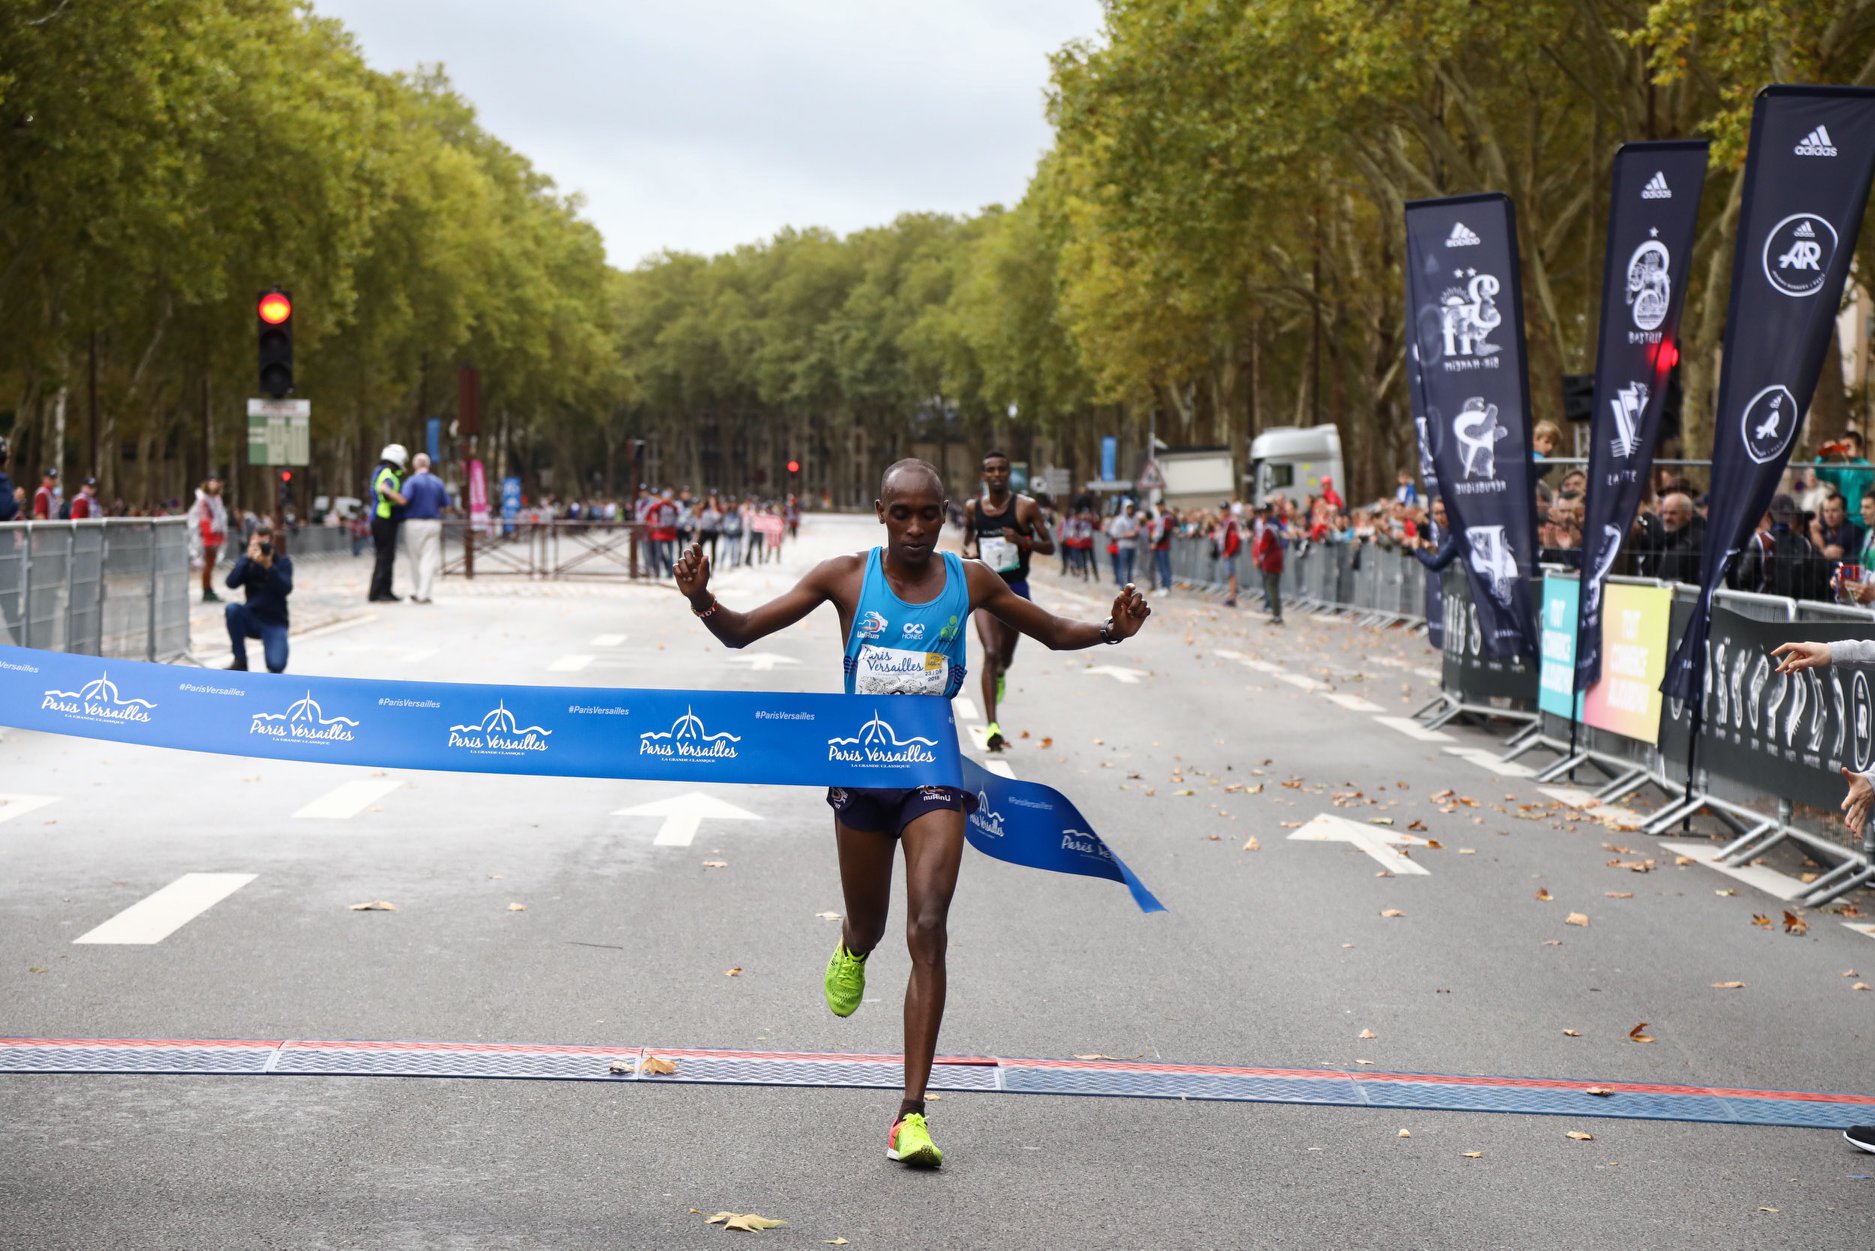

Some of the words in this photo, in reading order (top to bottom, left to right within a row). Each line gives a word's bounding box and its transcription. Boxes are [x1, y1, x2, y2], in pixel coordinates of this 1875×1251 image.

[1794, 145, 1838, 157] adidas
[1641, 189, 1672, 199] adidas
[863, 647, 892, 660] Paris
[867, 657, 924, 672] Versailles
[179, 683, 246, 697] #ParisVersailles
[41, 695, 81, 713] Paris
[84, 701, 152, 723] Versailles
[379, 697, 441, 709] #ParisVersailles
[568, 705, 630, 716] #ParisVersailles
[755, 710, 816, 721] #ParisVersailles
[250, 719, 287, 736] Paris
[290, 723, 355, 742] Versailles
[448, 731, 484, 749] Paris
[486, 734, 549, 752] Versailles
[639, 739, 674, 756] Paris
[676, 739, 739, 758] Versailles
[828, 745, 863, 762] Paris
[865, 744, 936, 763] Versailles
[1061, 834, 1094, 853] Paris
